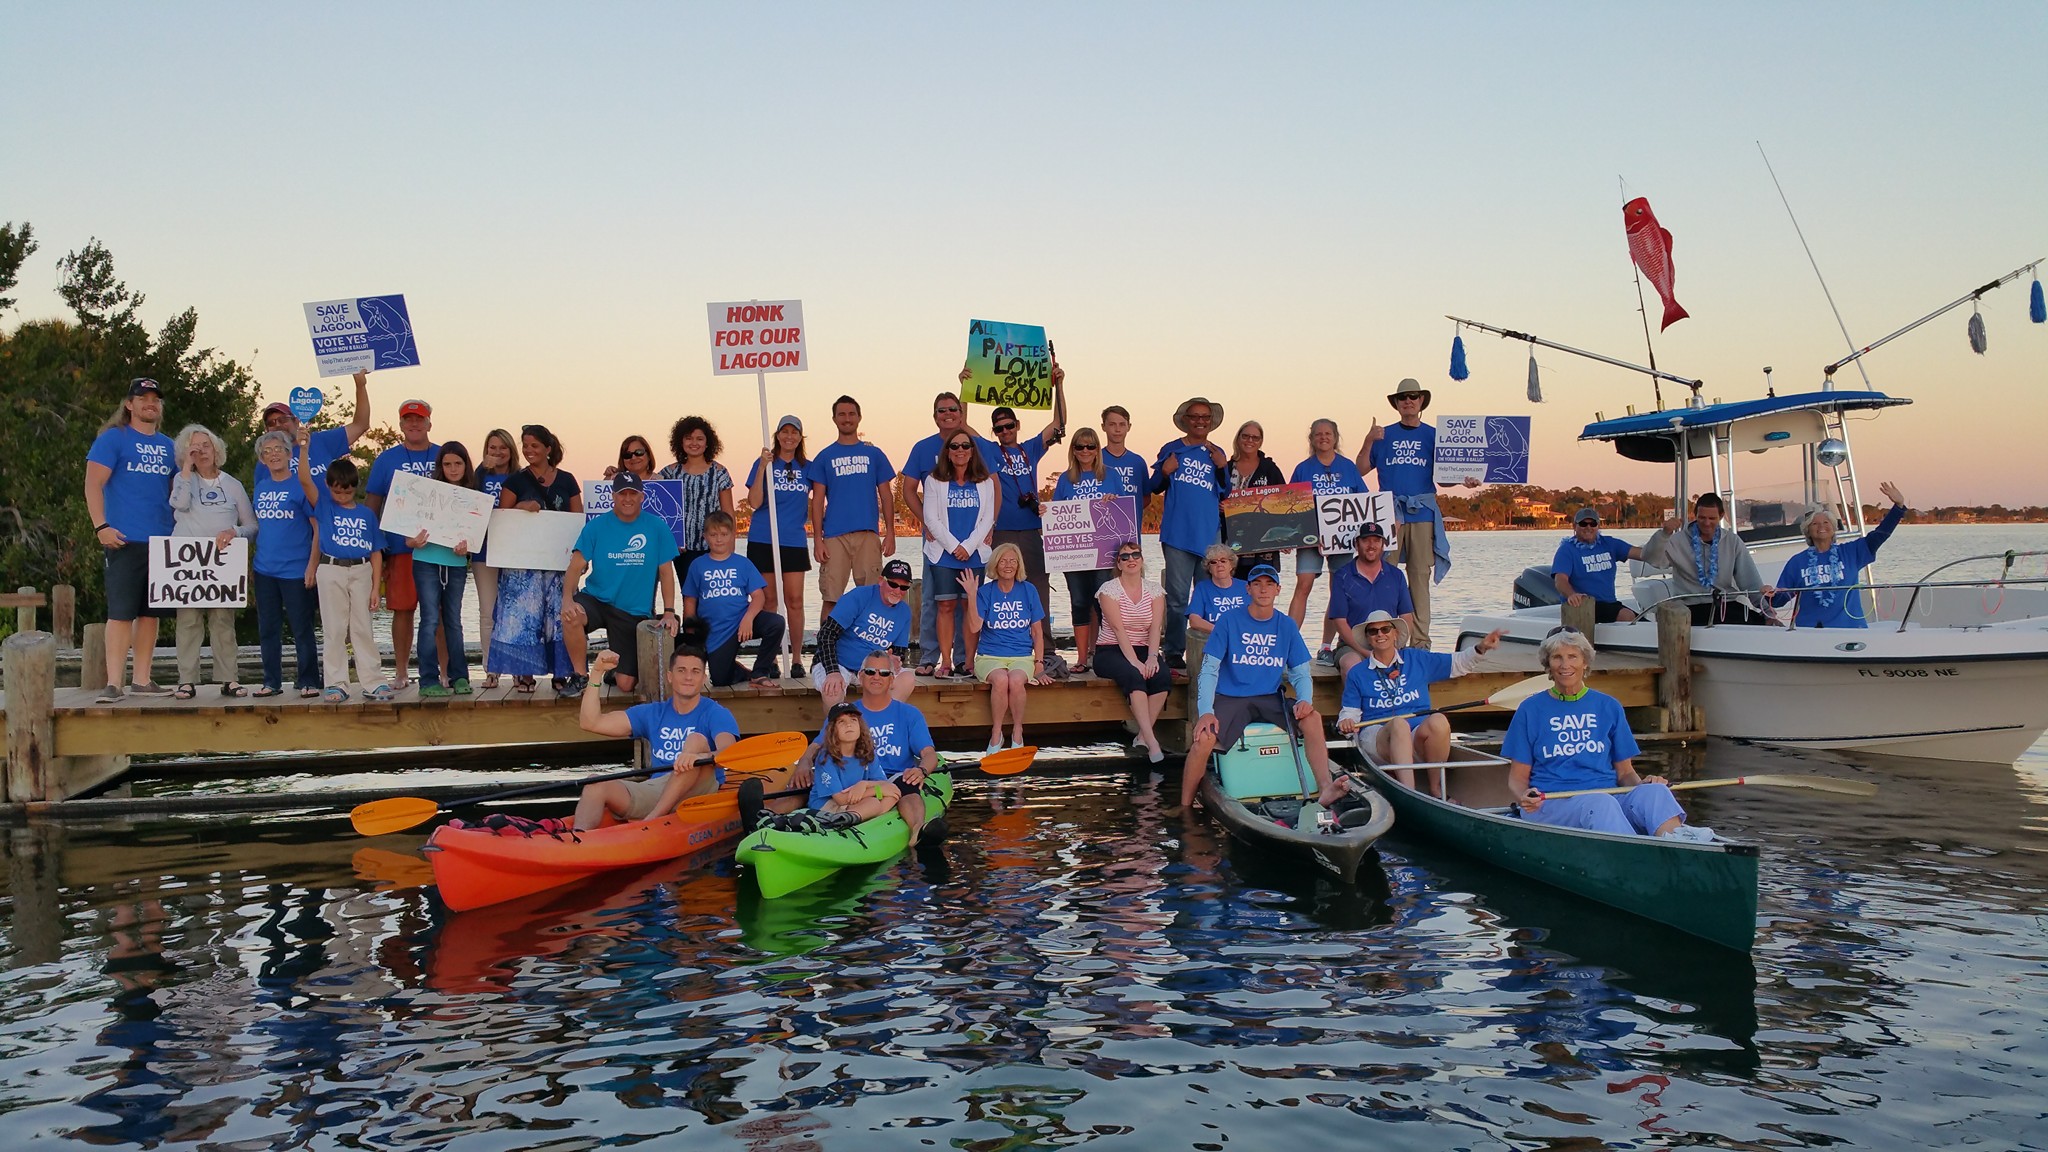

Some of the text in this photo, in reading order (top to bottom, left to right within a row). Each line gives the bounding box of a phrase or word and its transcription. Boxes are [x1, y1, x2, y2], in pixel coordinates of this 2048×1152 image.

[316, 303, 349, 316] SAVE
[726, 304, 784, 323] HONK
[323, 314, 346, 324] OUR
[313, 320, 362, 333] LAGOON
[970, 321, 998, 336] ALL
[316, 334, 367, 348] VOTE YES
[715, 327, 800, 346] FOR OUR
[982, 337, 1046, 358] PARTIES
[720, 350, 800, 370] LAGOON
[993, 355, 1049, 380] LOVE
[297, 390, 314, 398] Our
[975, 384, 1053, 407] LAGOON
[291, 397, 321, 406] Lagoon
[1446, 419, 1476, 429] SAVE
[1450, 428, 1471, 436] OUR
[1392, 440, 1422, 450] SAVE
[1439, 435, 1483, 444] LAGOON
[135, 442, 168, 457] SAVE
[1395, 449, 1416, 457] OUR
[1438, 448, 1485, 457] VOTE YES
[141, 455, 164, 465] OUR
[831, 455, 870, 468] LOVE OUR
[1183, 457, 1212, 474] SAVE
[1385, 456, 1427, 467] LAGOON
[835, 464, 868, 477] LAGOON
[1185, 467, 1206, 479] OUR
[485, 481, 503, 491] SA
[1076, 486, 1098, 494] OUR
[1241, 489, 1254, 497] Our
[1255, 487, 1280, 496] Lagoon
[1312, 486, 1350, 496] AGOON
[258, 491, 289, 501] SAVE
[258, 501, 279, 509] OUR
[1051, 504, 1082, 516] SAVE
[1321, 493, 1387, 525] SAVE
[255, 509, 294, 519] AGOON
[1056, 514, 1077, 523] OUR
[333, 516, 367, 531] SAVE
[1046, 520, 1091, 532] LAGOON
[337, 527, 362, 538] OUR
[1047, 533, 1093, 545] VOTE YES
[164, 539, 231, 568] LOVE
[607, 552, 646, 560] SURFRIDER
[1596, 552, 1612, 562] OUR
[703, 568, 737, 581] SAVE
[149, 575, 246, 605] LAGOON!
[709, 579, 732, 589] OUR
[993, 600, 1024, 612] SAVE
[1213, 596, 1245, 606] SAVE
[997, 611, 1020, 620] OUR
[867, 612, 895, 632] SAVE
[868, 625, 888, 639] OUR
[1241, 632, 1277, 647] SAVE
[1245, 645, 1270, 656] OUR
[1232, 653, 1284, 668] LAGOON
[1858, 668, 1960, 678] FL 9008 NE
[1369, 689, 1420, 709] LAGOON
[1549, 713, 1597, 732] SAVE
[869, 723, 895, 738] AVE
[1558, 729, 1591, 742] OUR
[1542, 740, 1605, 759] LAGOON
[688, 828, 713, 846] OCEAN
